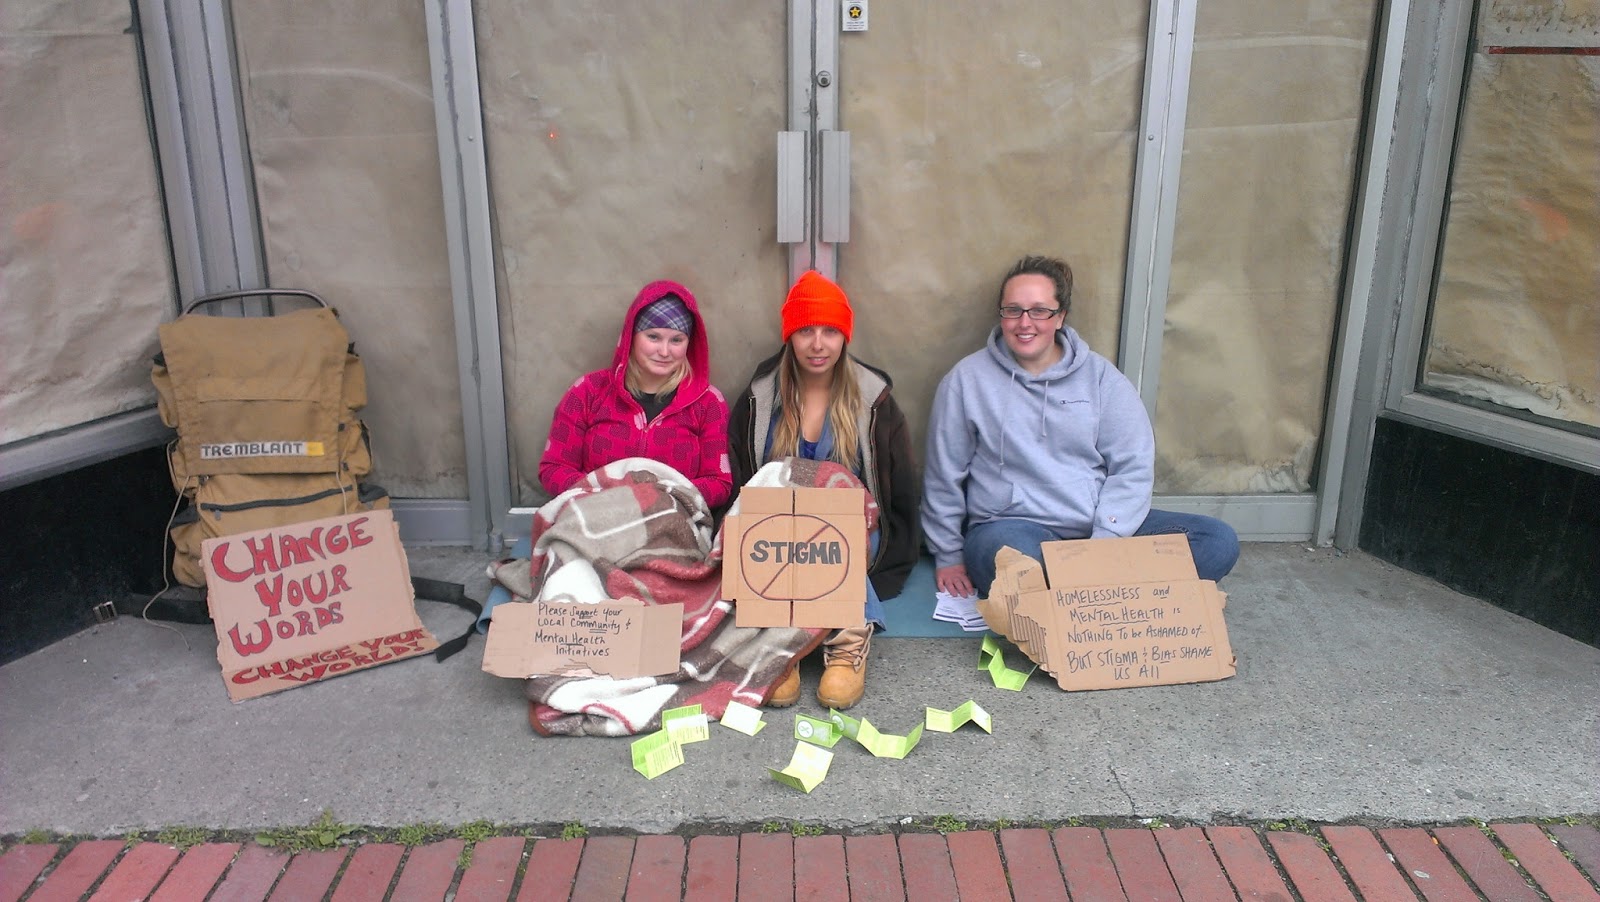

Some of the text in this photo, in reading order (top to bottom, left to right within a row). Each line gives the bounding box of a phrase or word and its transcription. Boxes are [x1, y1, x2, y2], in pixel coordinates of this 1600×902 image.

[201, 443, 303, 456] TREMBLANT
[211, 517, 373, 582] CHANGE
[750, 540, 842, 564] STIGMA
[255, 564, 352, 617] YOUR
[1056, 585, 1169, 607] HOMELESSNESS and
[538, 602, 567, 616] Please
[1069, 607, 1119, 624] MENTAL
[1121, 606, 1164, 621] HEALTH
[227, 602, 344, 657] WORDS
[570, 618, 620, 635] Community
[1067, 624, 1113, 643] NOTHING
[1131, 628, 1142, 638] be
[1146, 625, 1188, 638] ASHAMED
[533, 629, 606, 644] Mental Health
[231, 627, 428, 685] CHANGE YOUR
[556, 645, 610, 657] Initiatives
[1066, 650, 1093, 673] BUT
[1097, 648, 1139, 667] STIGMA
[1180, 646, 1213, 659] SHAME
[1114, 667, 1131, 680] US
